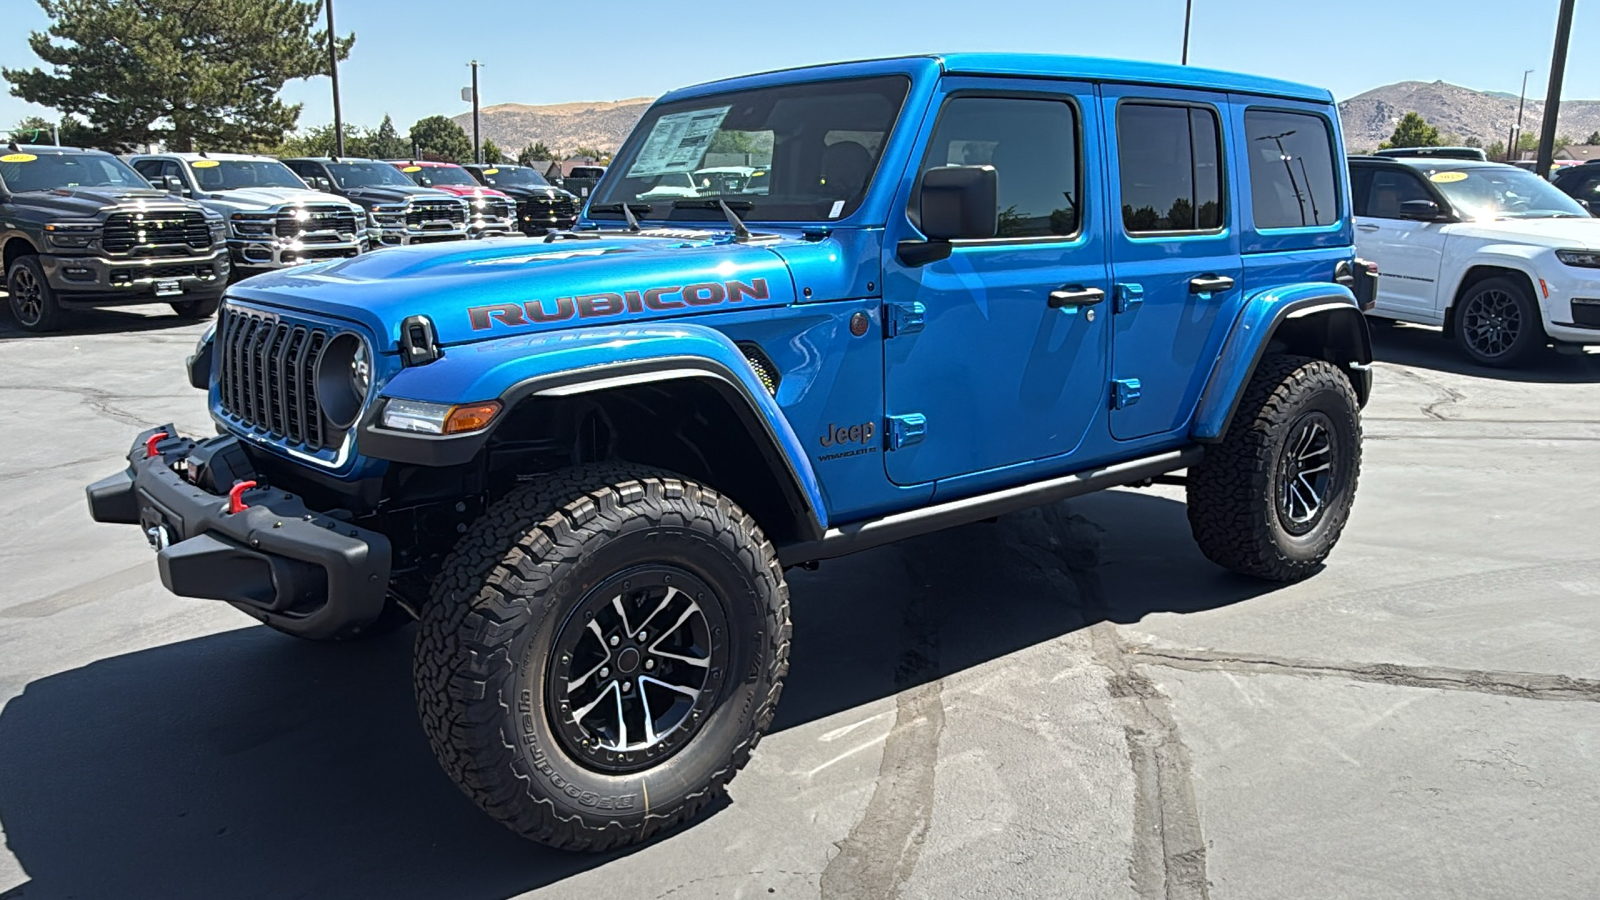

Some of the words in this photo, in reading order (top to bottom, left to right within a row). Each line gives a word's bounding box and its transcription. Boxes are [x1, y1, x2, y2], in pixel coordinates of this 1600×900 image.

[467, 278, 770, 331] RUBICON
[820, 421, 875, 447] Jeep
[818, 448, 868, 462] WRANGLER
